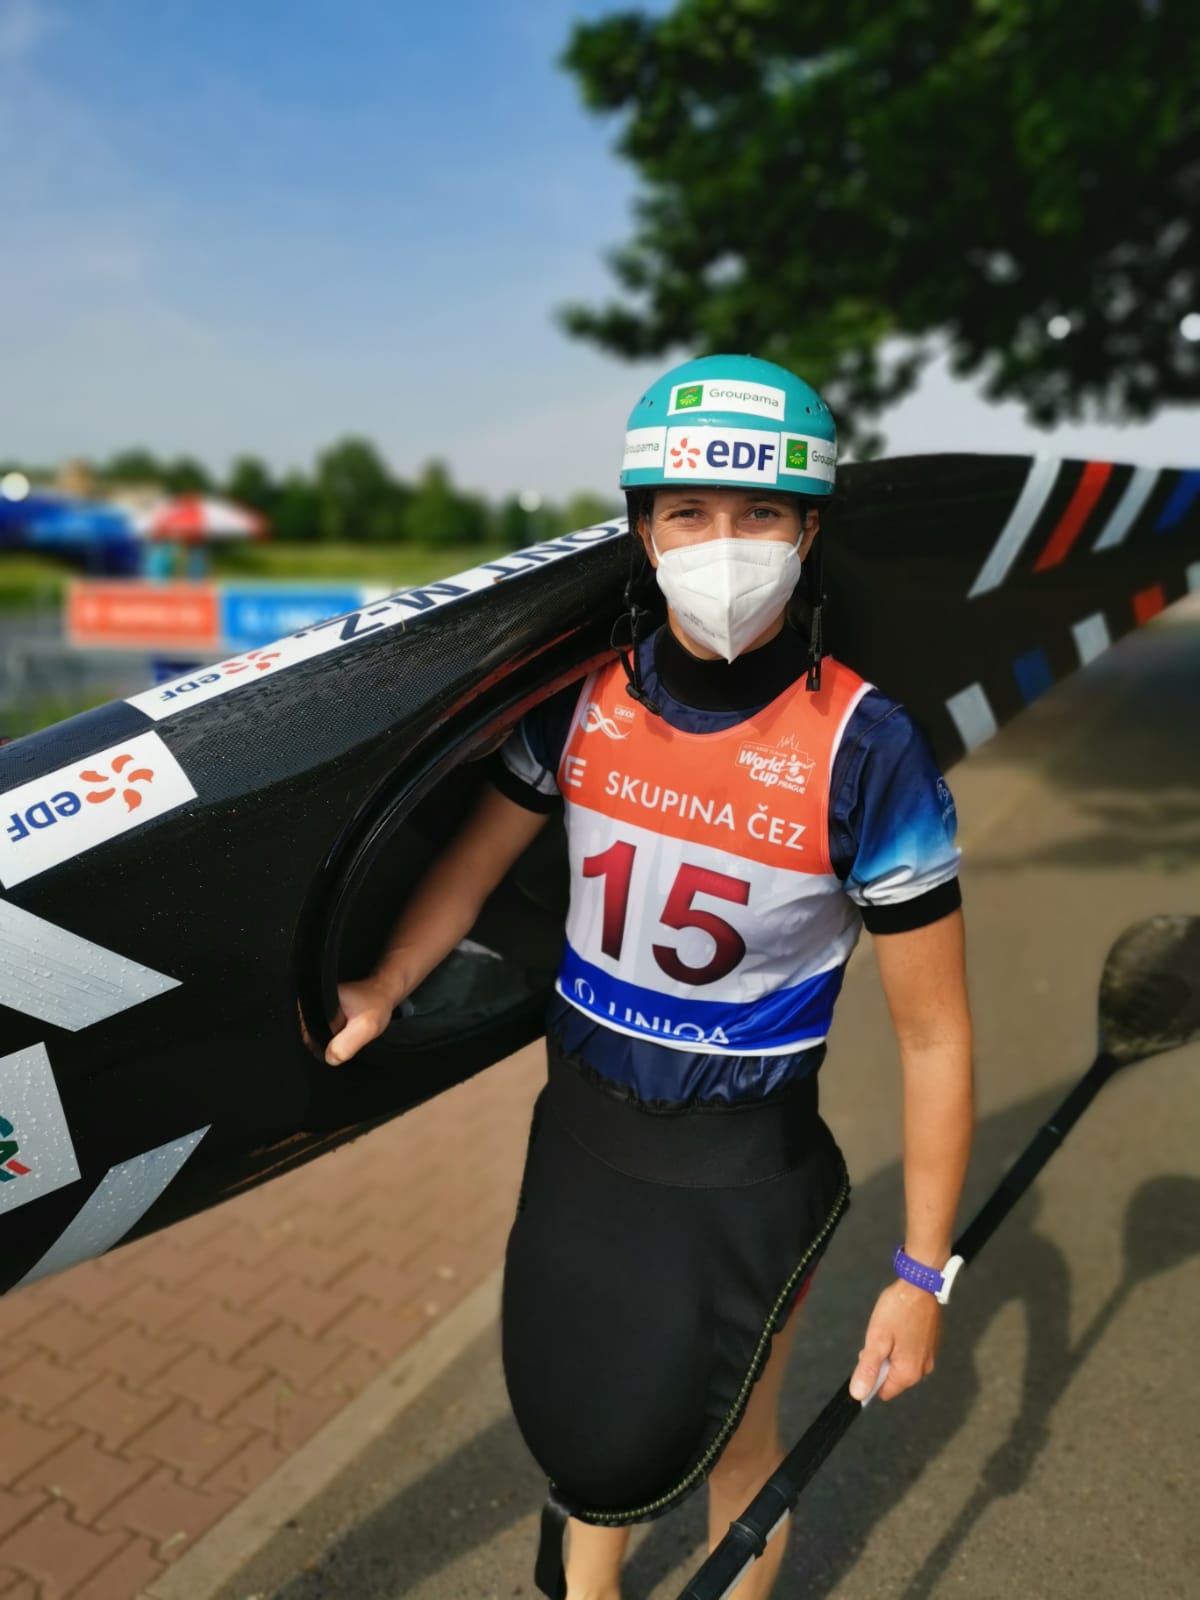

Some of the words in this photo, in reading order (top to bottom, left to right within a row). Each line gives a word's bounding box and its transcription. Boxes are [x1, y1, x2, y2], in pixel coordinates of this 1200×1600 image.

[709, 388, 779, 408] Groupama
[739, 749, 787, 774] World
[749, 767, 779, 788] Cup
[605, 770, 736, 831] SKUPINA
[747, 803, 807, 850] ČEZ
[582, 840, 751, 986] 15
